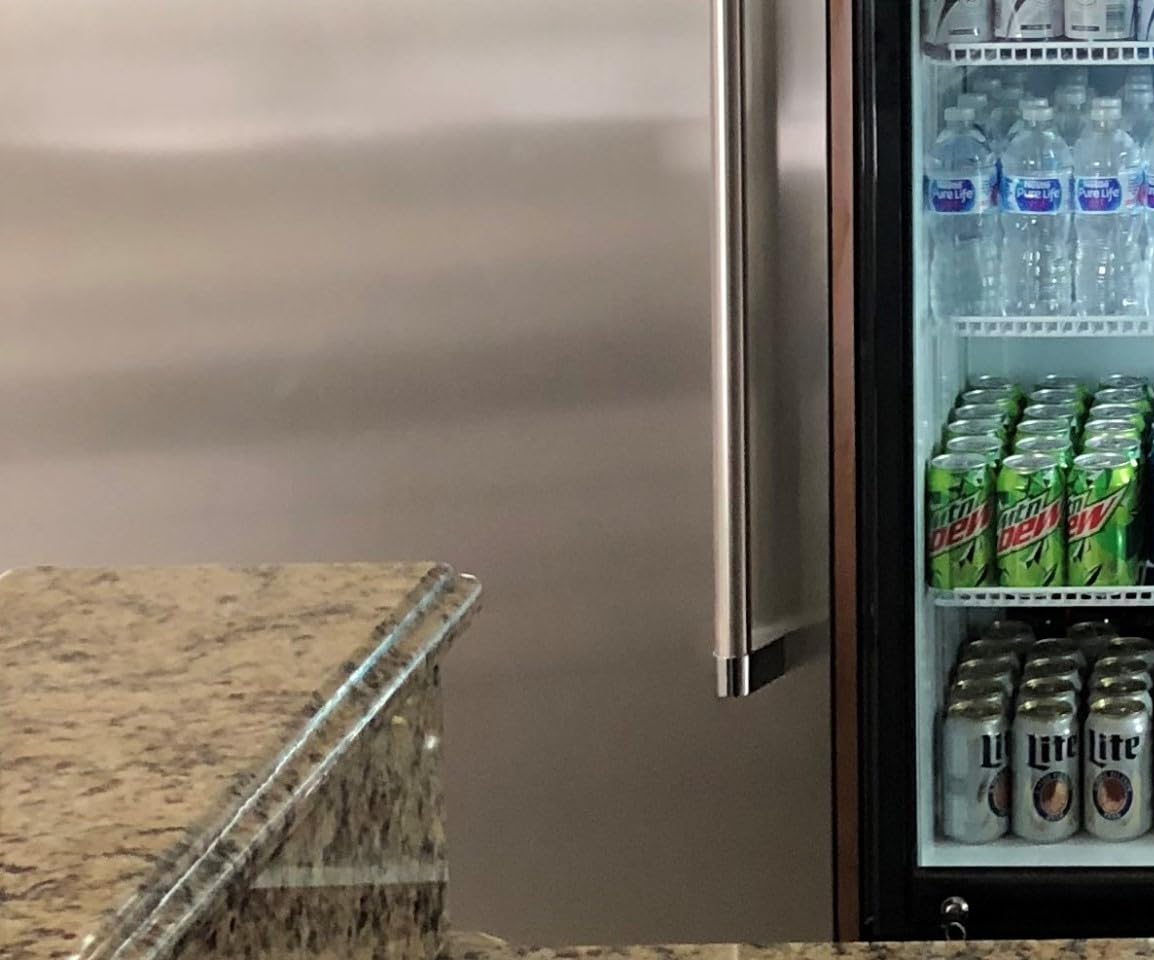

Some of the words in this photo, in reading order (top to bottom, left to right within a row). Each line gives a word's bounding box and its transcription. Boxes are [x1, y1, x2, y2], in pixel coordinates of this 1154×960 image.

[955, 188, 974, 203] Life
[1017, 187, 1041, 199] Pure
[1043, 187, 1060, 202] Life
[1078, 187, 1100, 198] Pure
[1101, 187, 1120, 202] Life
[1027, 733, 1078, 771] Lite
[1088, 729, 1140, 768] Lite
